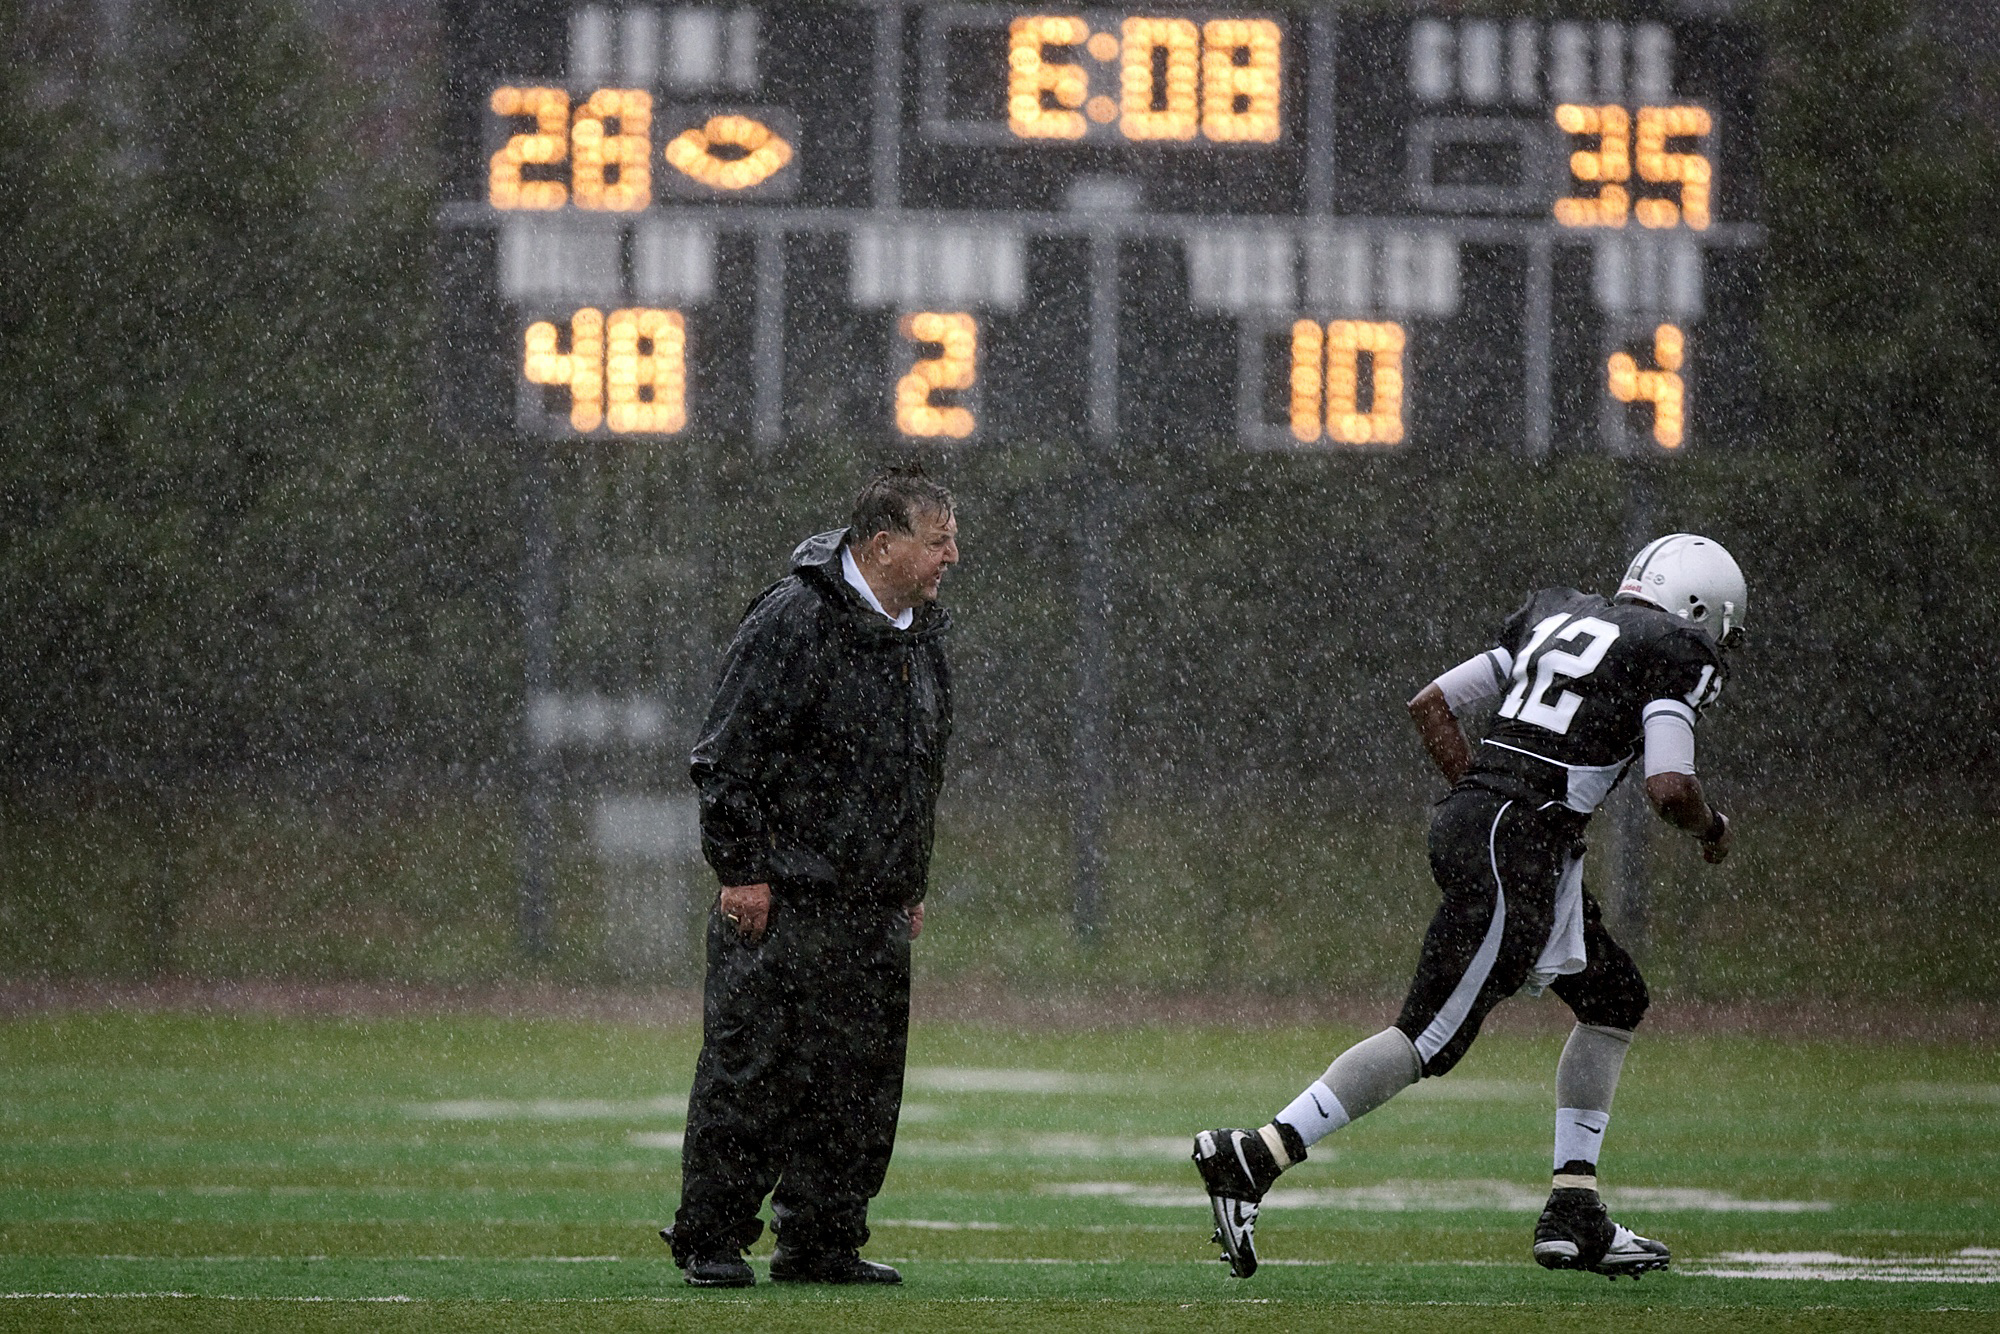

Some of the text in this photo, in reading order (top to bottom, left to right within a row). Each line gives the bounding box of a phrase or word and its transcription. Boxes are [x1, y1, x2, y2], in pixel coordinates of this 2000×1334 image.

[1008, 16, 1281, 142] 6:08
[490, 86, 652, 210] 28
[1556, 104, 1712, 230] 35
[524, 308, 686, 434] 48
[896, 312, 976, 438] 2
[1290, 320, 1405, 444] 10
[1608, 324, 1684, 448] 4
[1498, 612, 1620, 734] 12
